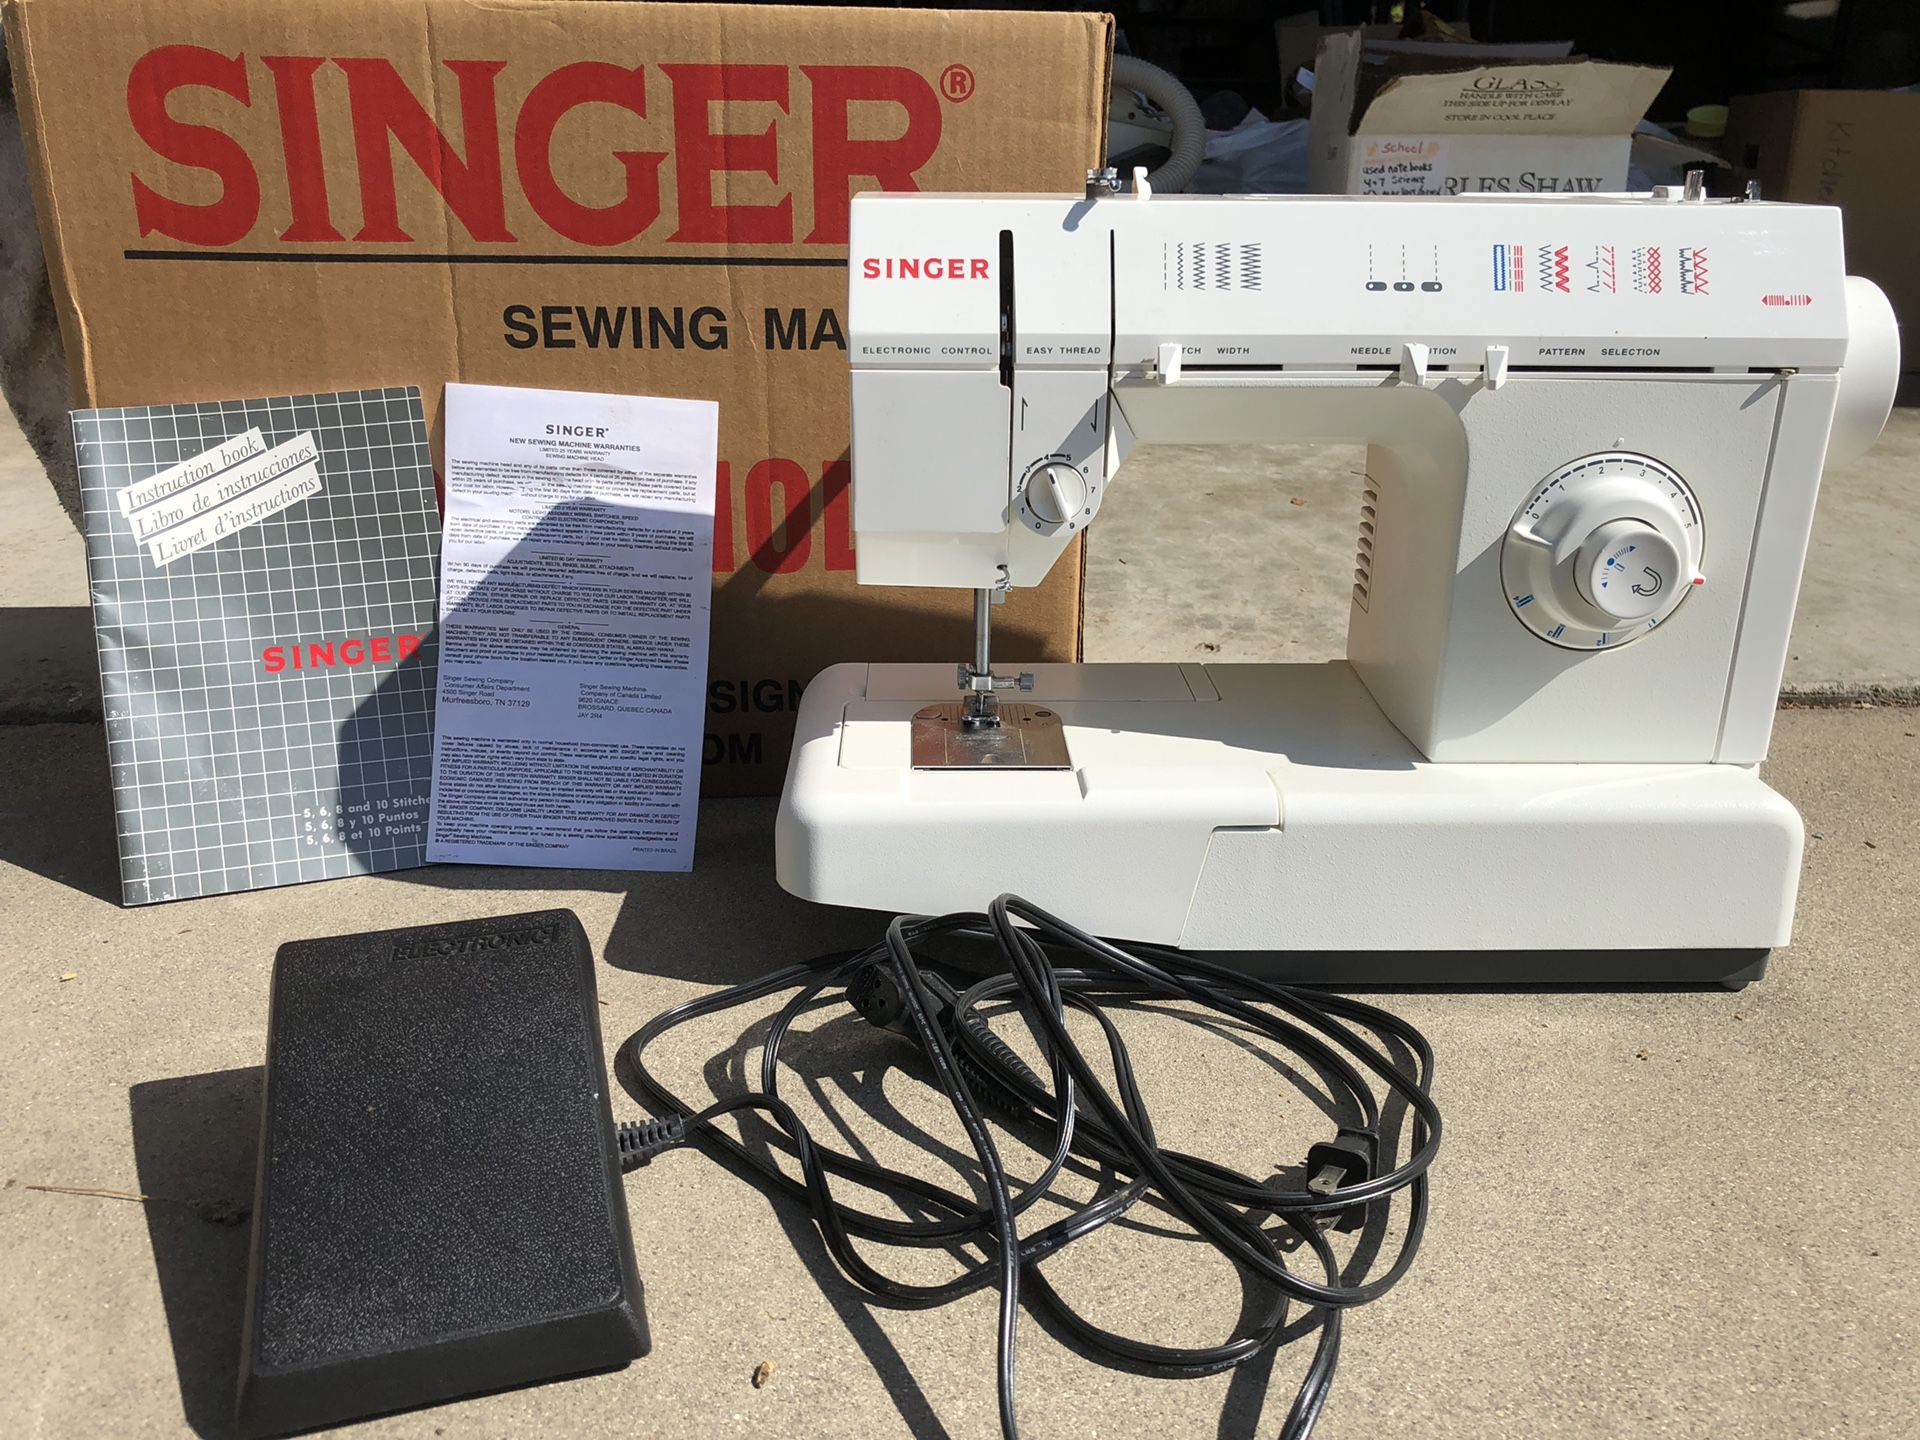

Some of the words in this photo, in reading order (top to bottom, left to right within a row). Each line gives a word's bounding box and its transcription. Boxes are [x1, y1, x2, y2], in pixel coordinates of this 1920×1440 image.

[1362, 165, 1385, 175] used
[862, 257, 991, 280] SINGER
[503, 305, 729, 351] SEWING
[763, 308, 847, 351] MA
[862, 346, 932, 356] ELECTRONIC
[941, 346, 993, 356] CONTROL
[1026, 346, 1054, 356] EASY
[1059, 346, 1102, 356] THREAD
[1180, 346, 1202, 356] TCH
[1216, 346, 1251, 356] WIDTH
[1350, 346, 1392, 355] NEEDLE
[1428, 346, 1458, 356] ITION
[1538, 347, 1586, 357] PATTERN
[1601, 347, 1661, 357] SELECTION
[527, 438, 557, 446] SEWING
[558, 440, 591, 448] MACHINE
[592, 442, 640, 451] WARRANTIES
[127, 463, 216, 508] Instruction
[221, 438, 262, 467] book
[1598, 466, 1605, 475] 2
[1639, 469, 1647, 478] 3
[135, 507, 185, 537] Libro
[192, 492, 212, 514] de
[216, 444, 313, 500] instrucciones
[1558, 484, 1566, 492] 1
[1670, 491, 1678, 499] 4
[155, 528, 209, 562] Livret
[213, 475, 317, 536] d'instructions
[1531, 512, 1540, 520] 0
[441, 696, 492, 705] Murfreesboro,
[507, 699, 530, 707] 37129
[336, 805, 343, 814] 8
[348, 802, 370, 813] and
[376, 799, 388, 809] 10
[337, 818, 344, 828] 8
[349, 819, 356, 829] y
[362, 814, 374, 825] 10
[378, 812, 420, 823] Puntos
[338, 832, 346, 841] 8
[368, 828, 381, 837] 10
[385, 824, 422, 836] Points
